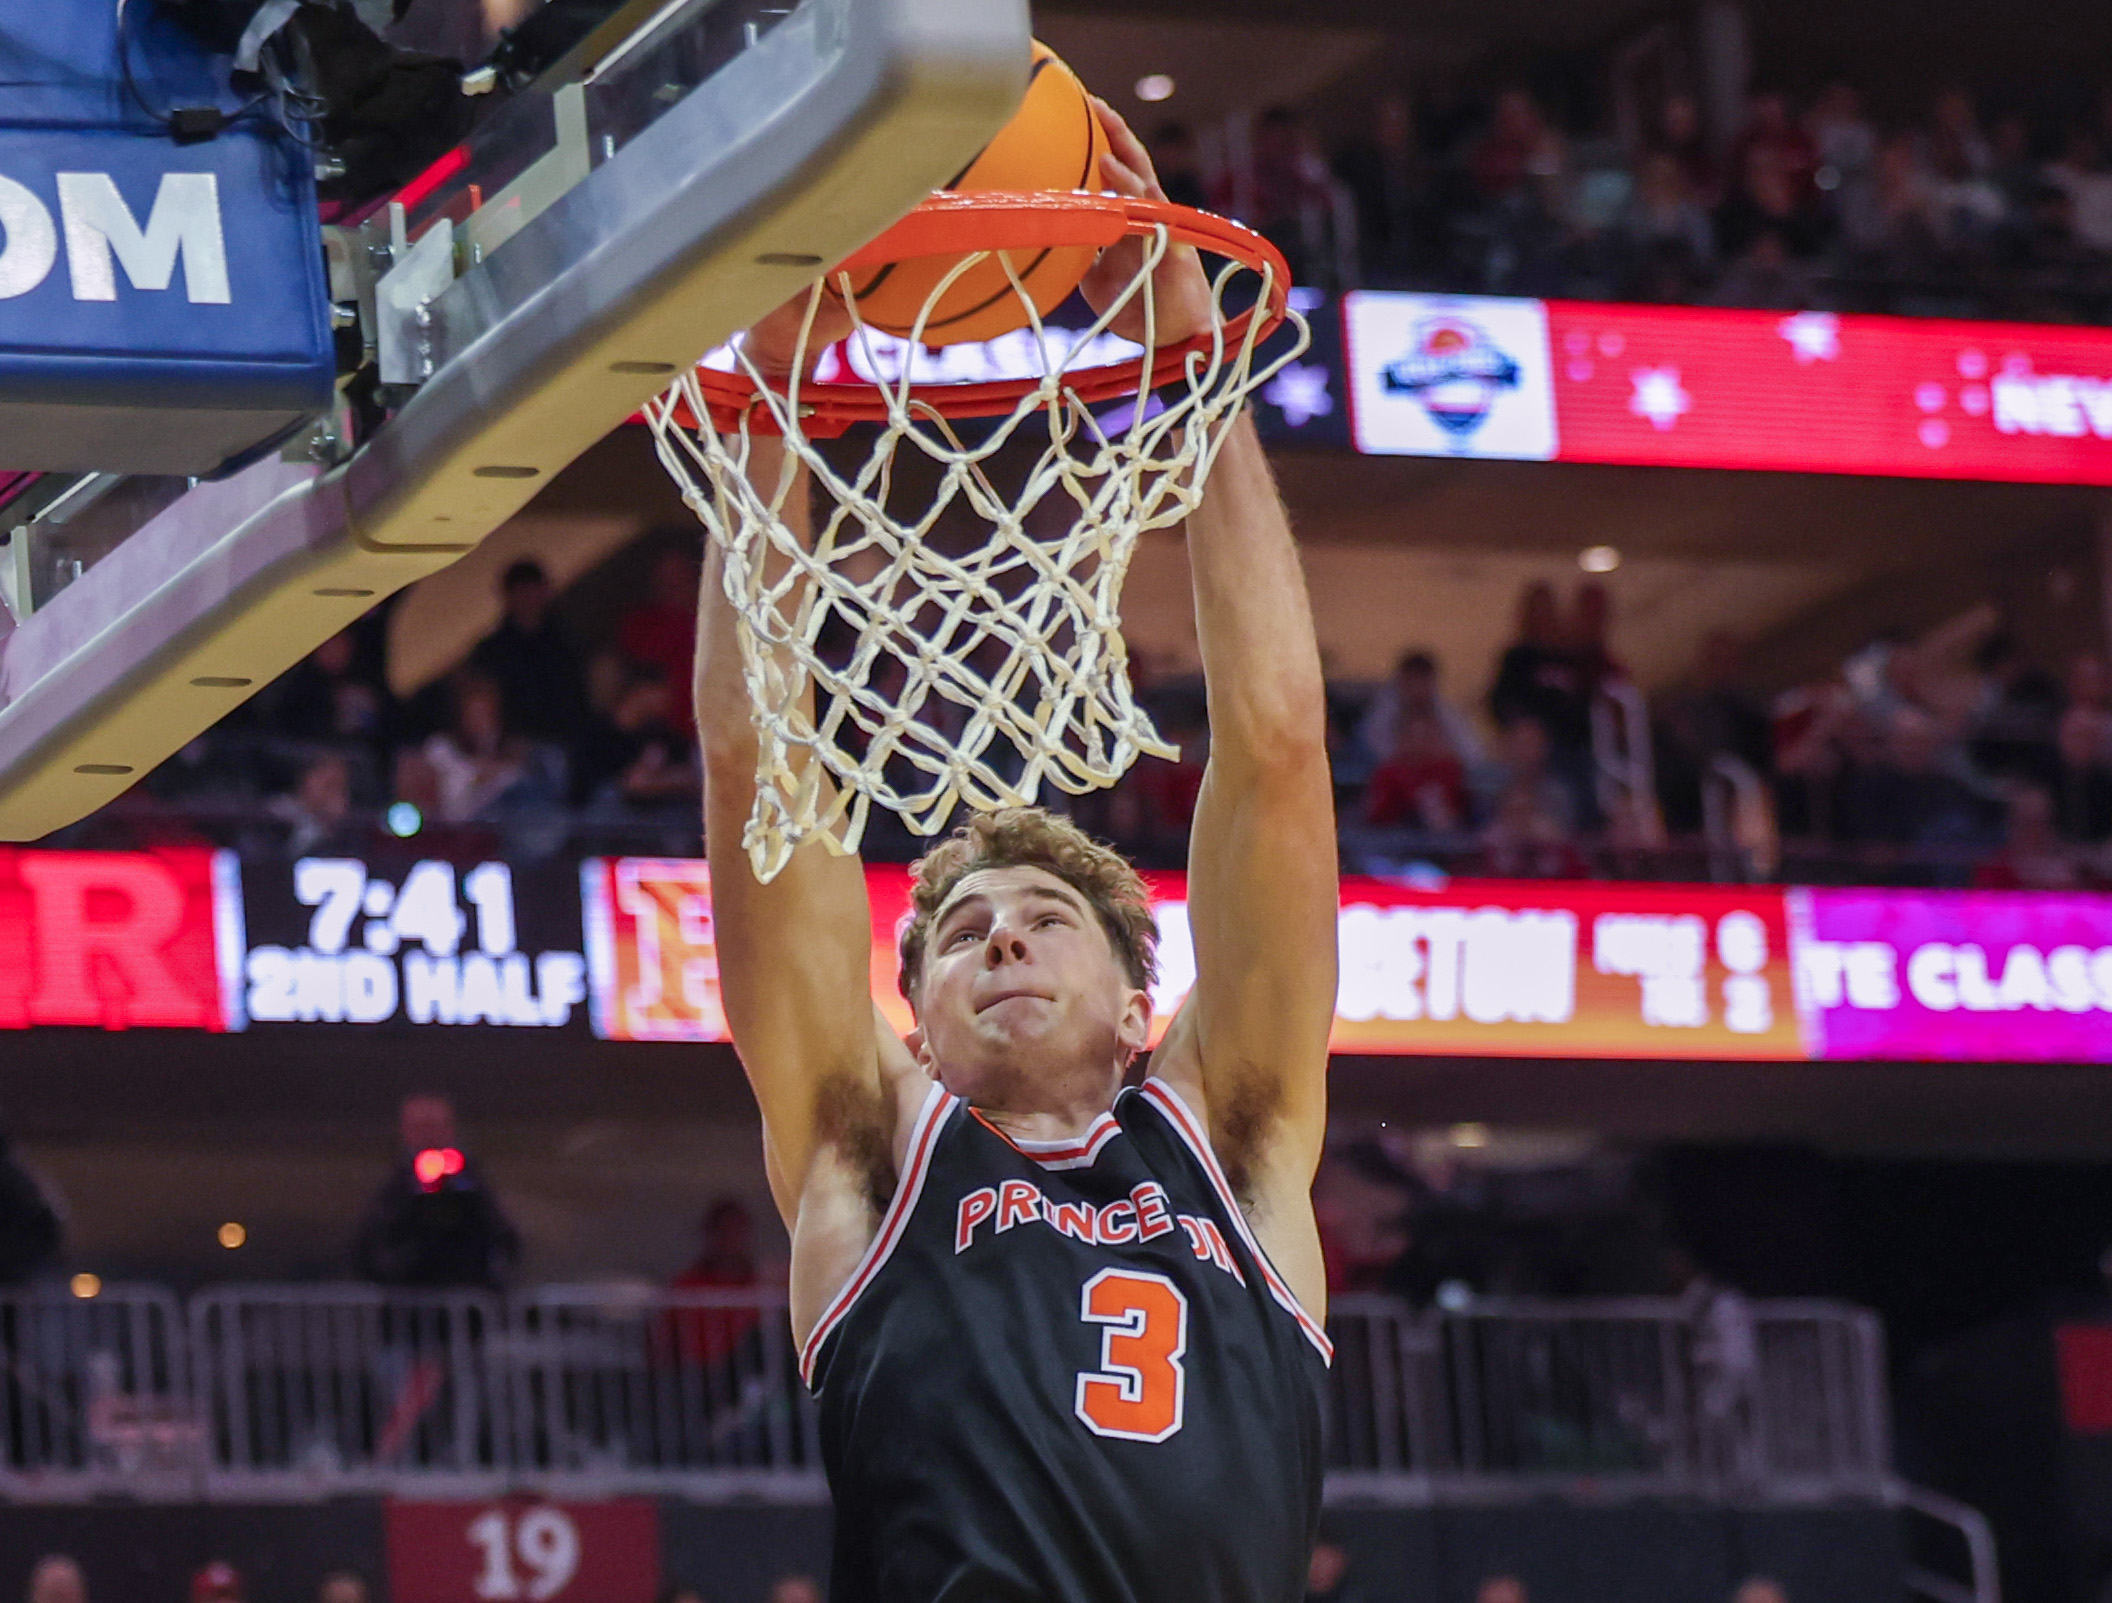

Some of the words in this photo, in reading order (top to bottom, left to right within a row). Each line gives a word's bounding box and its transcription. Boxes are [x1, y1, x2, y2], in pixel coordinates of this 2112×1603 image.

[18, 854, 204, 1027] R
[296, 859, 516, 957] 7:41
[246, 946, 396, 1021] 2ND
[407, 952, 583, 1026] HALF
[955, 1179, 1246, 1288] PRINCEON
[1074, 1266, 1188, 1444] 3
[466, 1507, 582, 1601] 19
